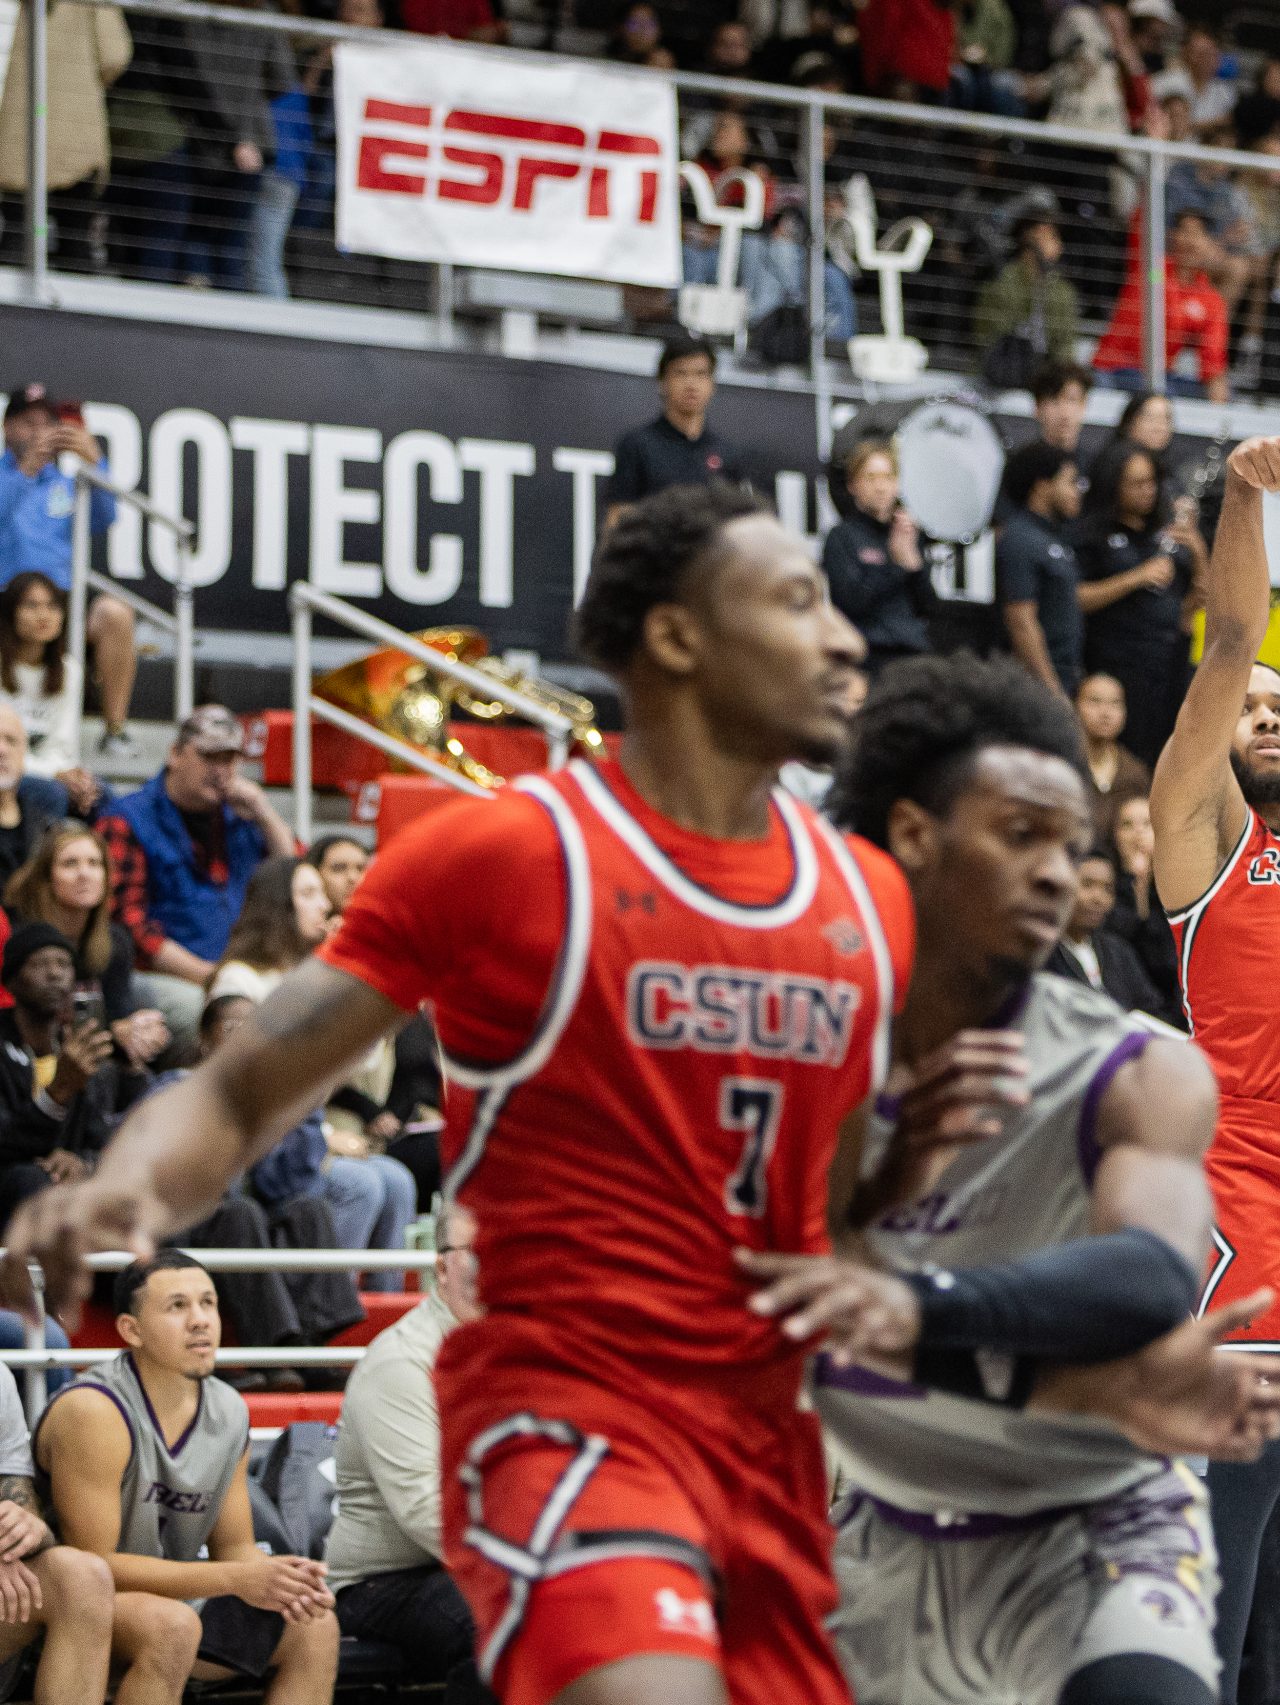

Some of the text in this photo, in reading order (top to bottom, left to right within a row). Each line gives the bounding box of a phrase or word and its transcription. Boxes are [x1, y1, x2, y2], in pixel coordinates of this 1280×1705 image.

[357, 97, 661, 222] ESPN
[0, 393, 535, 608] ROTECT
[626, 960, 862, 1068] CSUN
[719, 1076, 784, 1218] 7
